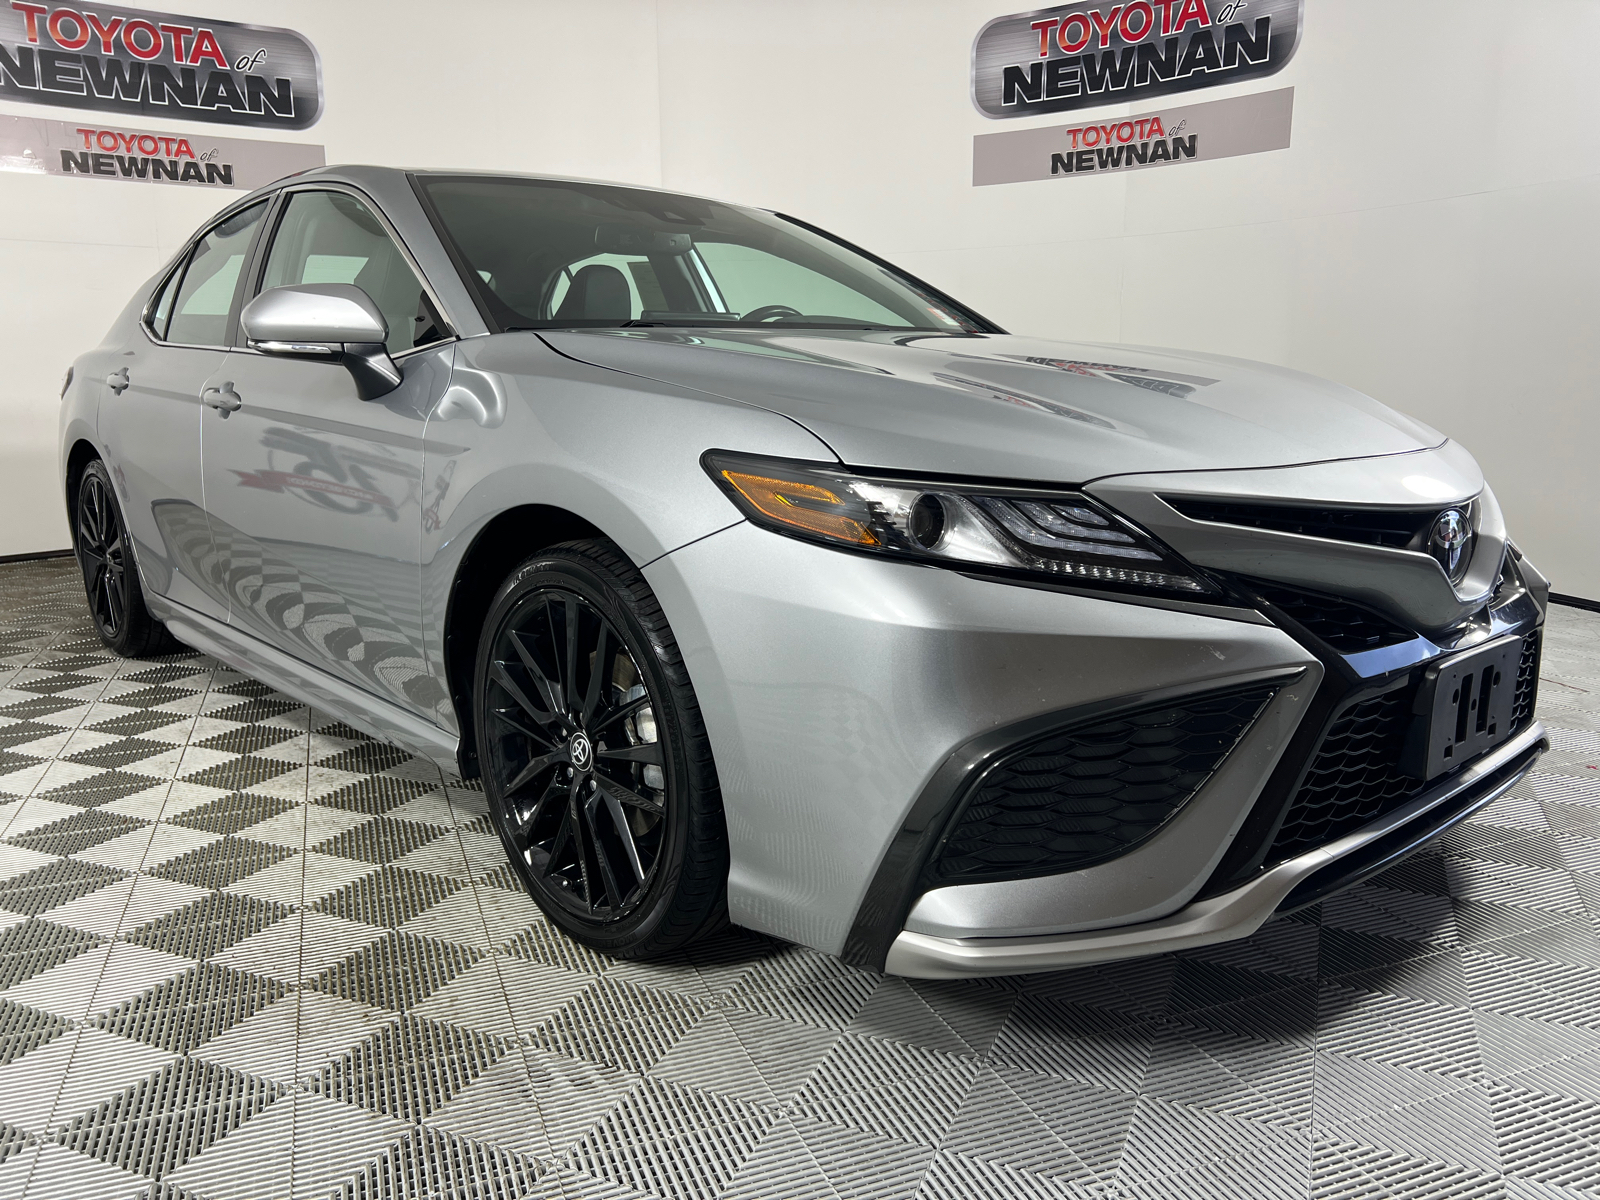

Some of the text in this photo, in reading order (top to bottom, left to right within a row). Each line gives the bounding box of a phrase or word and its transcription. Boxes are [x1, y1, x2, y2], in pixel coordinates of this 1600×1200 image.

[11, 2, 267, 72] TOYOTA of
[1030, 0, 1247, 58] TOYOTA of
[0, 43, 295, 117] NEWNAN
[1001, 14, 1272, 106] NEWNAN
[76, 128, 220, 162] TOYOTA of
[1050, 133, 1198, 176] NEWNAN
[1066, 116, 1187, 149] TOYOTA of
[60, 149, 235, 187] NEWNAN
